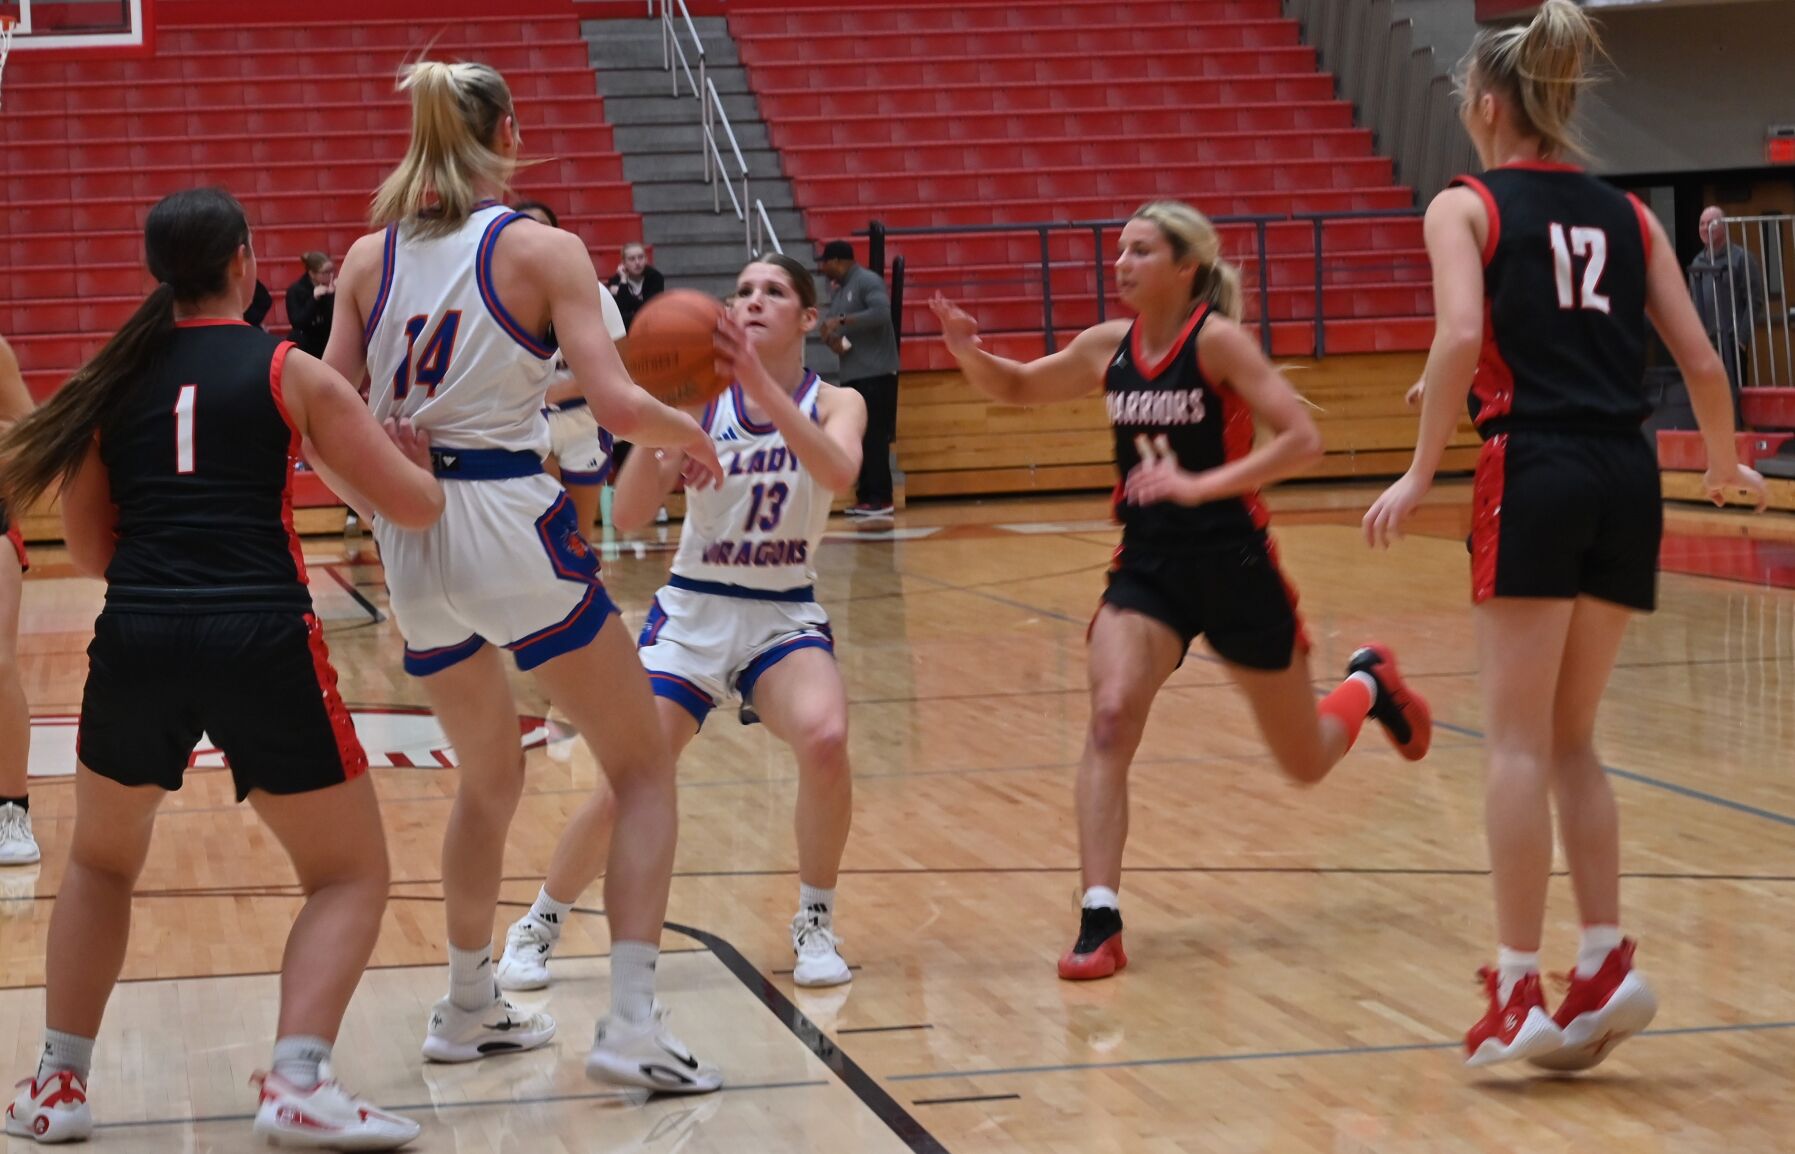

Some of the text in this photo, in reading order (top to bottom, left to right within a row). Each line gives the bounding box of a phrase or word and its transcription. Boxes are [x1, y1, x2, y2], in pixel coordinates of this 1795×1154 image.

[1548, 221, 1611, 315] 12
[393, 309, 463, 400] 14
[172, 384, 198, 474] 1
[743, 481, 788, 532] 13
